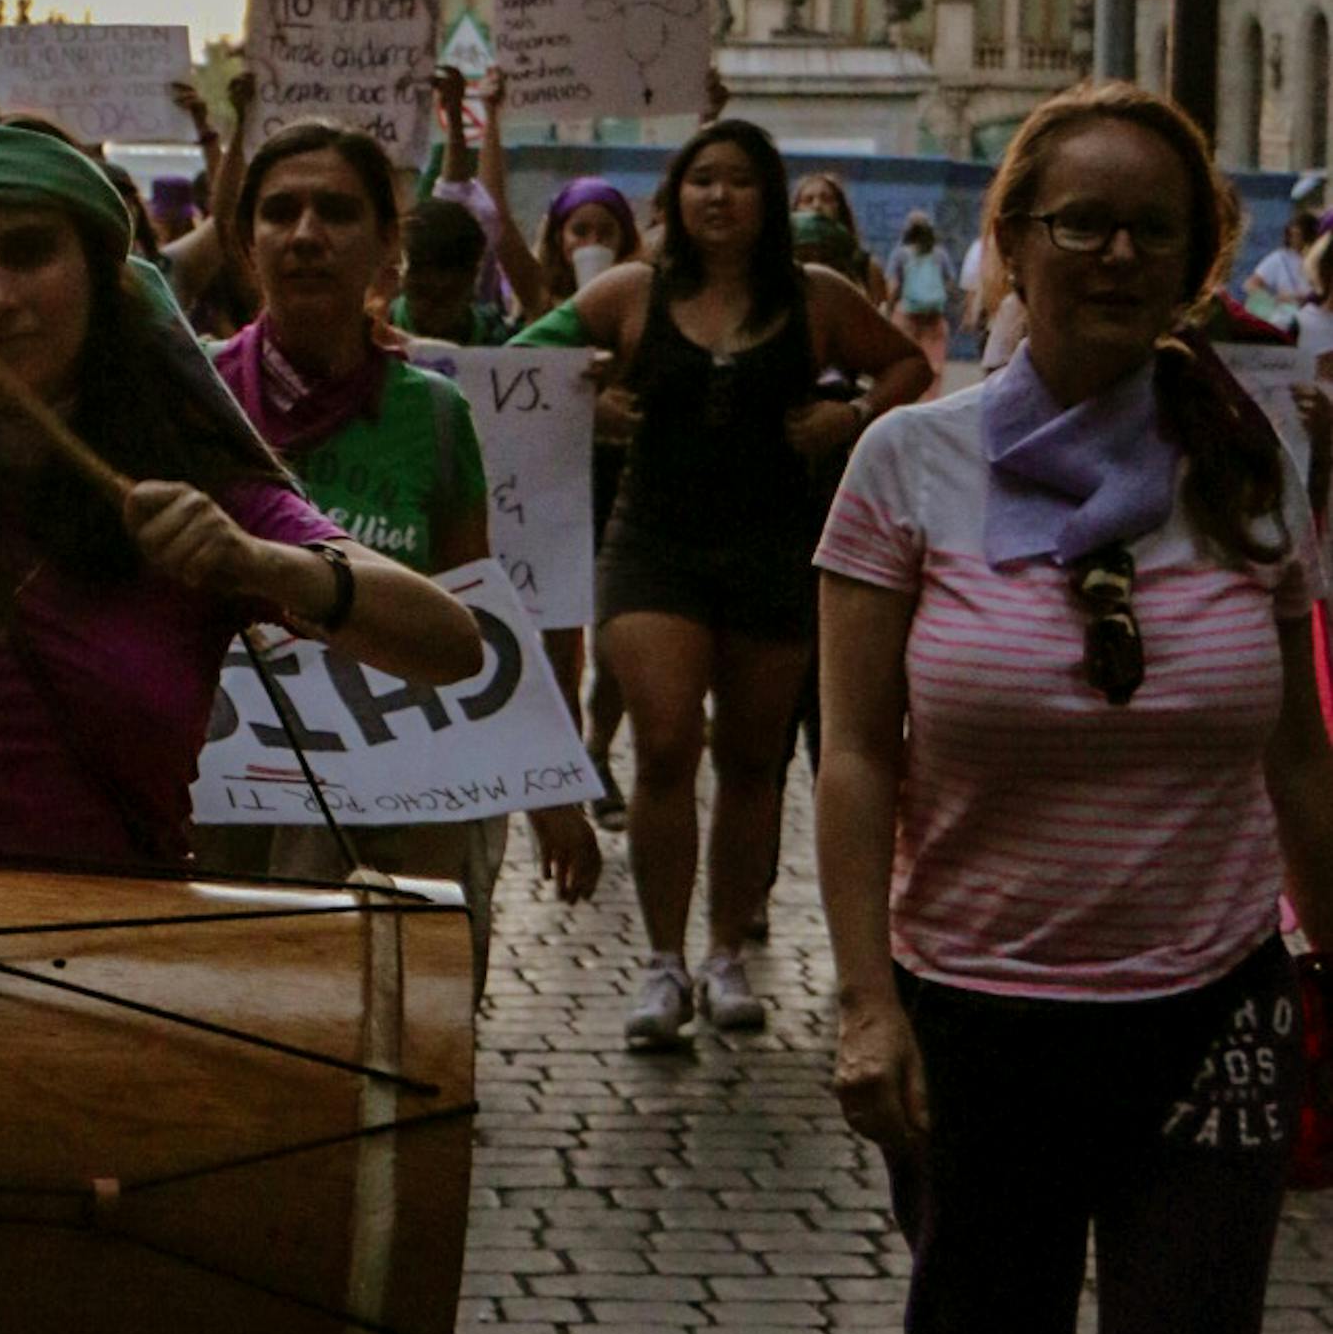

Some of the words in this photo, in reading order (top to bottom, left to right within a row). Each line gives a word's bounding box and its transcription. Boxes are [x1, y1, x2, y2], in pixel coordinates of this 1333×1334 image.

[206, 604, 522, 751] CHI
[523, 760, 586, 788] HOY
[225, 786, 279, 812] TI
[376, 775, 508, 811] MARCHO
